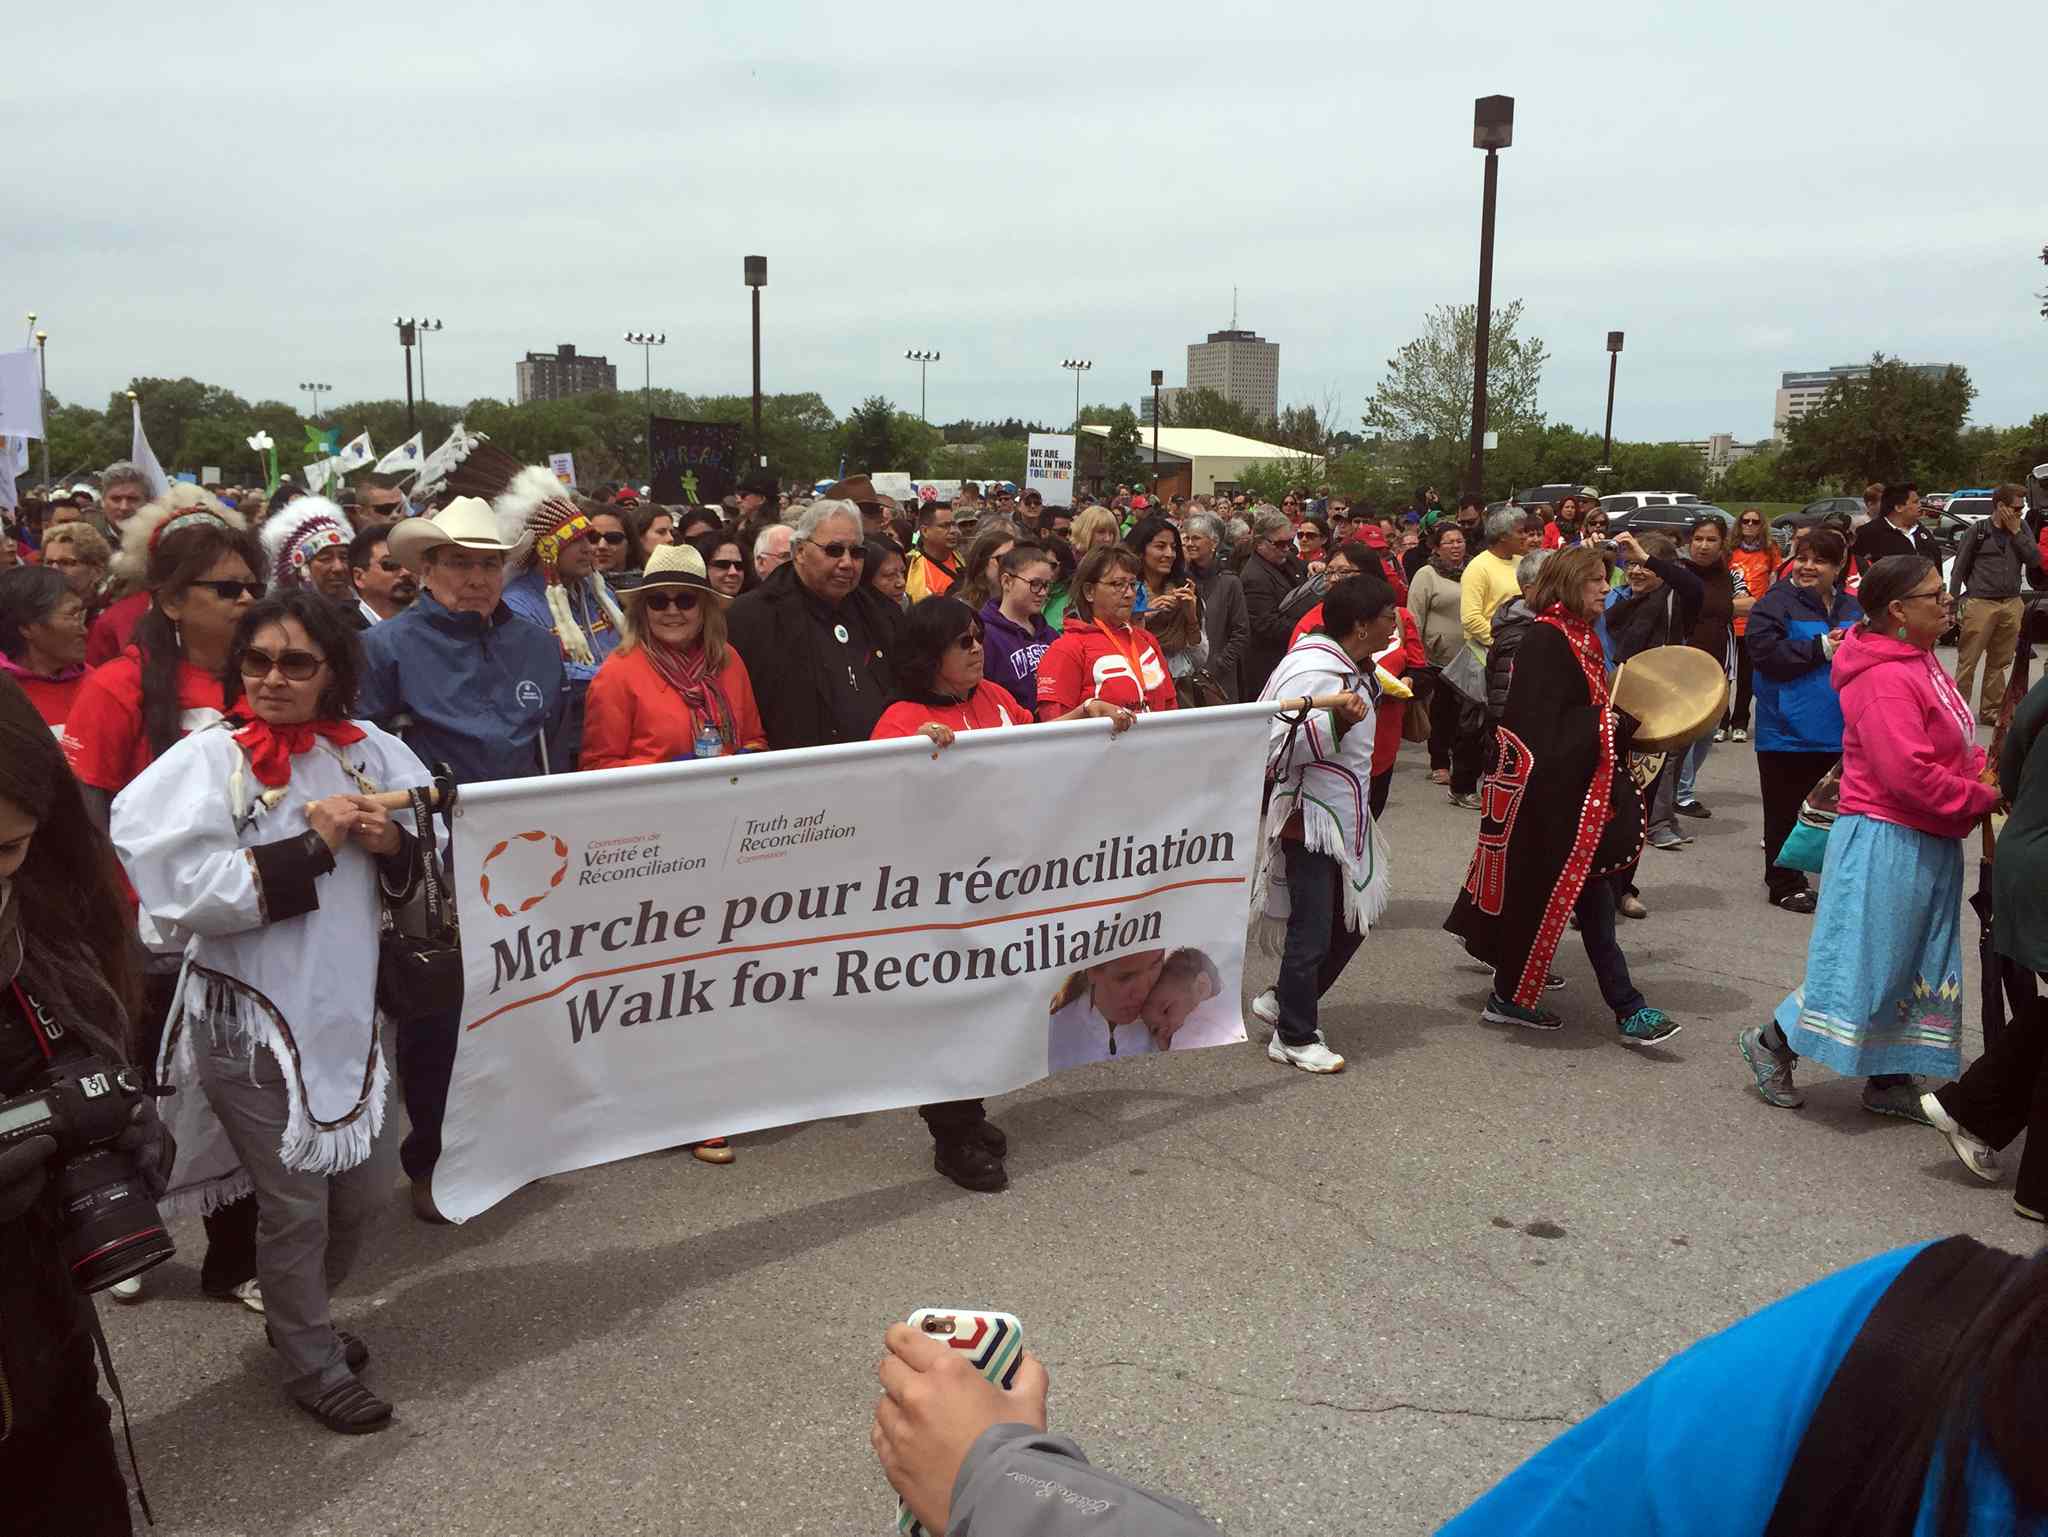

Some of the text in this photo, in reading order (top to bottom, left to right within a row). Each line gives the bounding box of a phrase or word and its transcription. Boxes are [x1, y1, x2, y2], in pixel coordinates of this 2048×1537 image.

[1030, 449, 1058, 459] WE ARE
[1030, 459, 1072, 470] ALL IN THIS
[745, 808, 825, 836] Truth and
[587, 834, 647, 850] Commission
[739, 824, 856, 854] Reconciliation
[584, 844, 660, 867] Vérité et
[736, 850, 787, 865] Commission
[578, 855, 706, 887] Réconciliation
[490, 828, 1235, 995] Marche pour la réconciliation
[566, 910, 1162, 1044] Walk for Reconciliation
